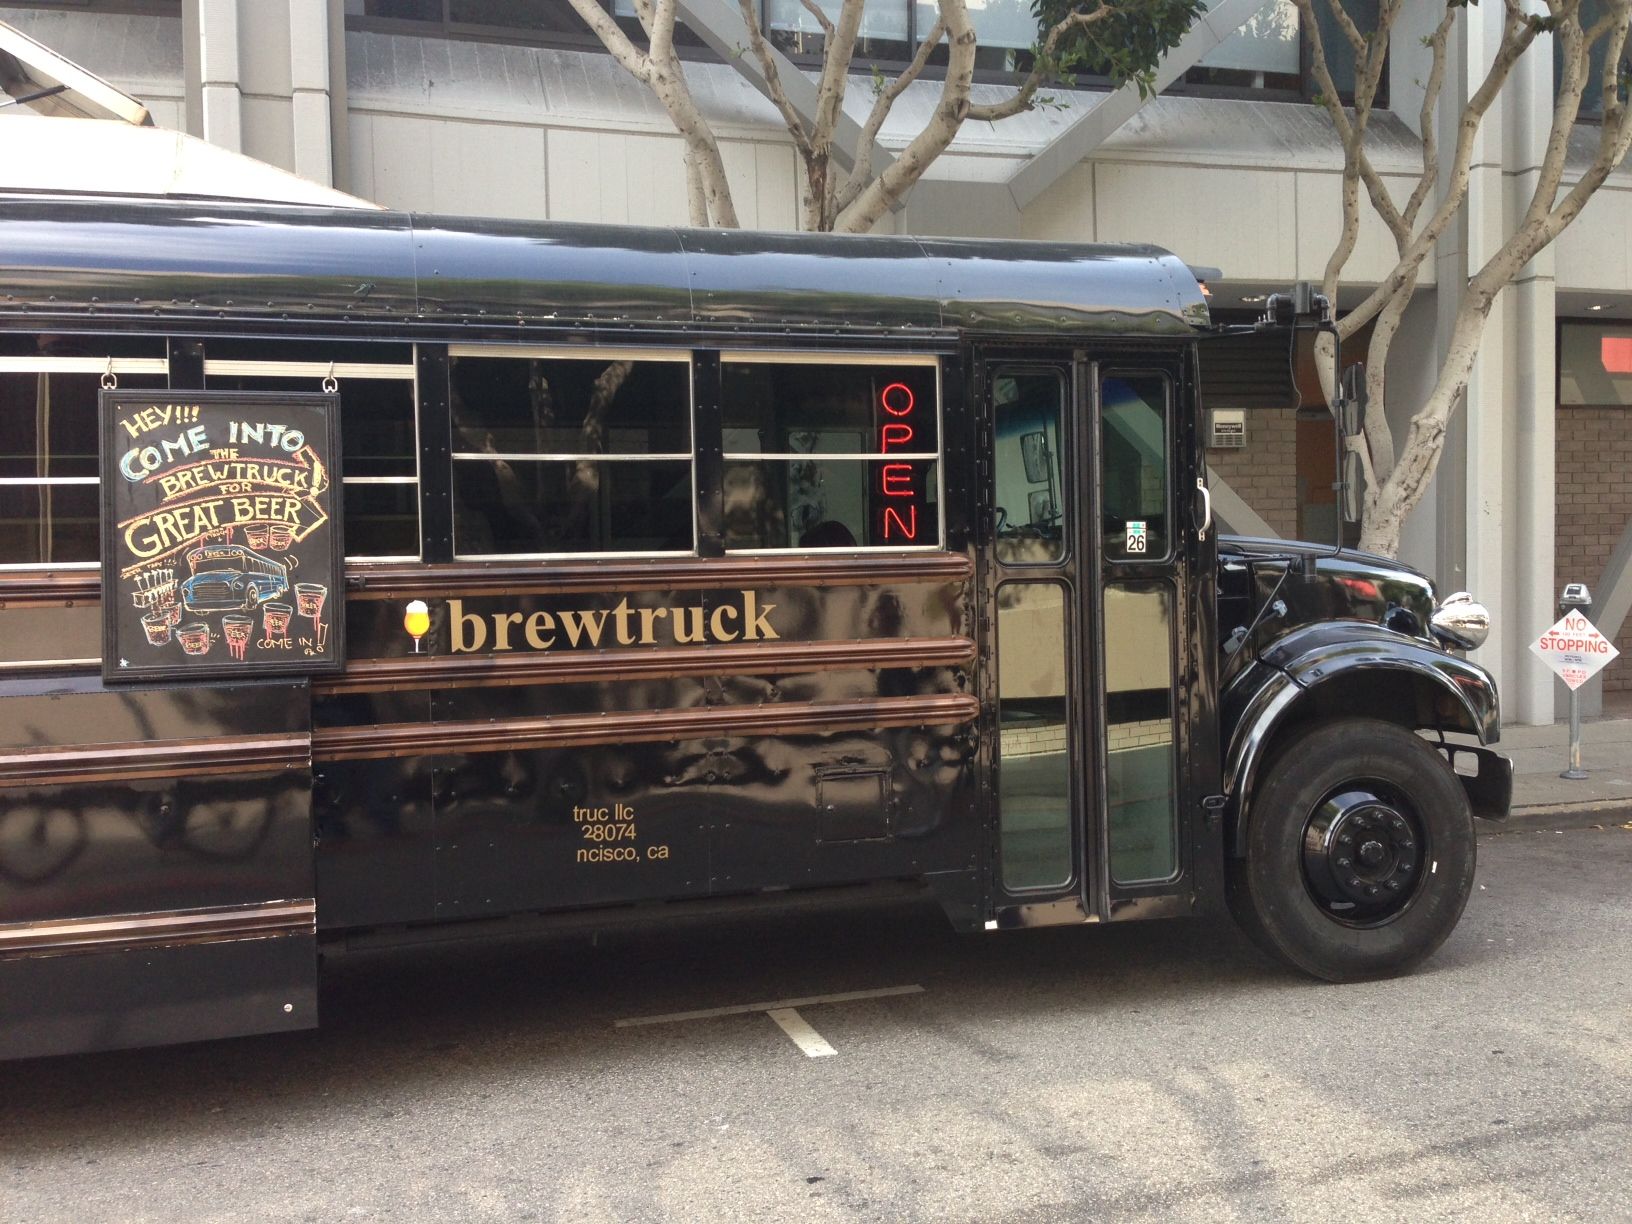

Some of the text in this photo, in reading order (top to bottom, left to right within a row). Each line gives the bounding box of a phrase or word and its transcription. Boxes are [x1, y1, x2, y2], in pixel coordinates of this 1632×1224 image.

[120, 405, 200, 439] HEY!!!
[119, 421, 305, 482] COME INTO
[209, 448, 240, 460] THE
[882, 383, 915, 539] OPEN
[219, 483, 253, 495] FOR
[124, 497, 302, 558] GREAT BEER
[1128, 535, 1145, 551] 26
[447, 590, 780, 653] brewtruck
[1565, 618, 1587, 631] NO
[256, 638, 293, 649] COME
[1540, 637, 1608, 653] STOPPING
[573, 803, 634, 821] truc llc
[581, 823, 637, 841] 28074
[577, 845, 669, 862] ncisco, ca
